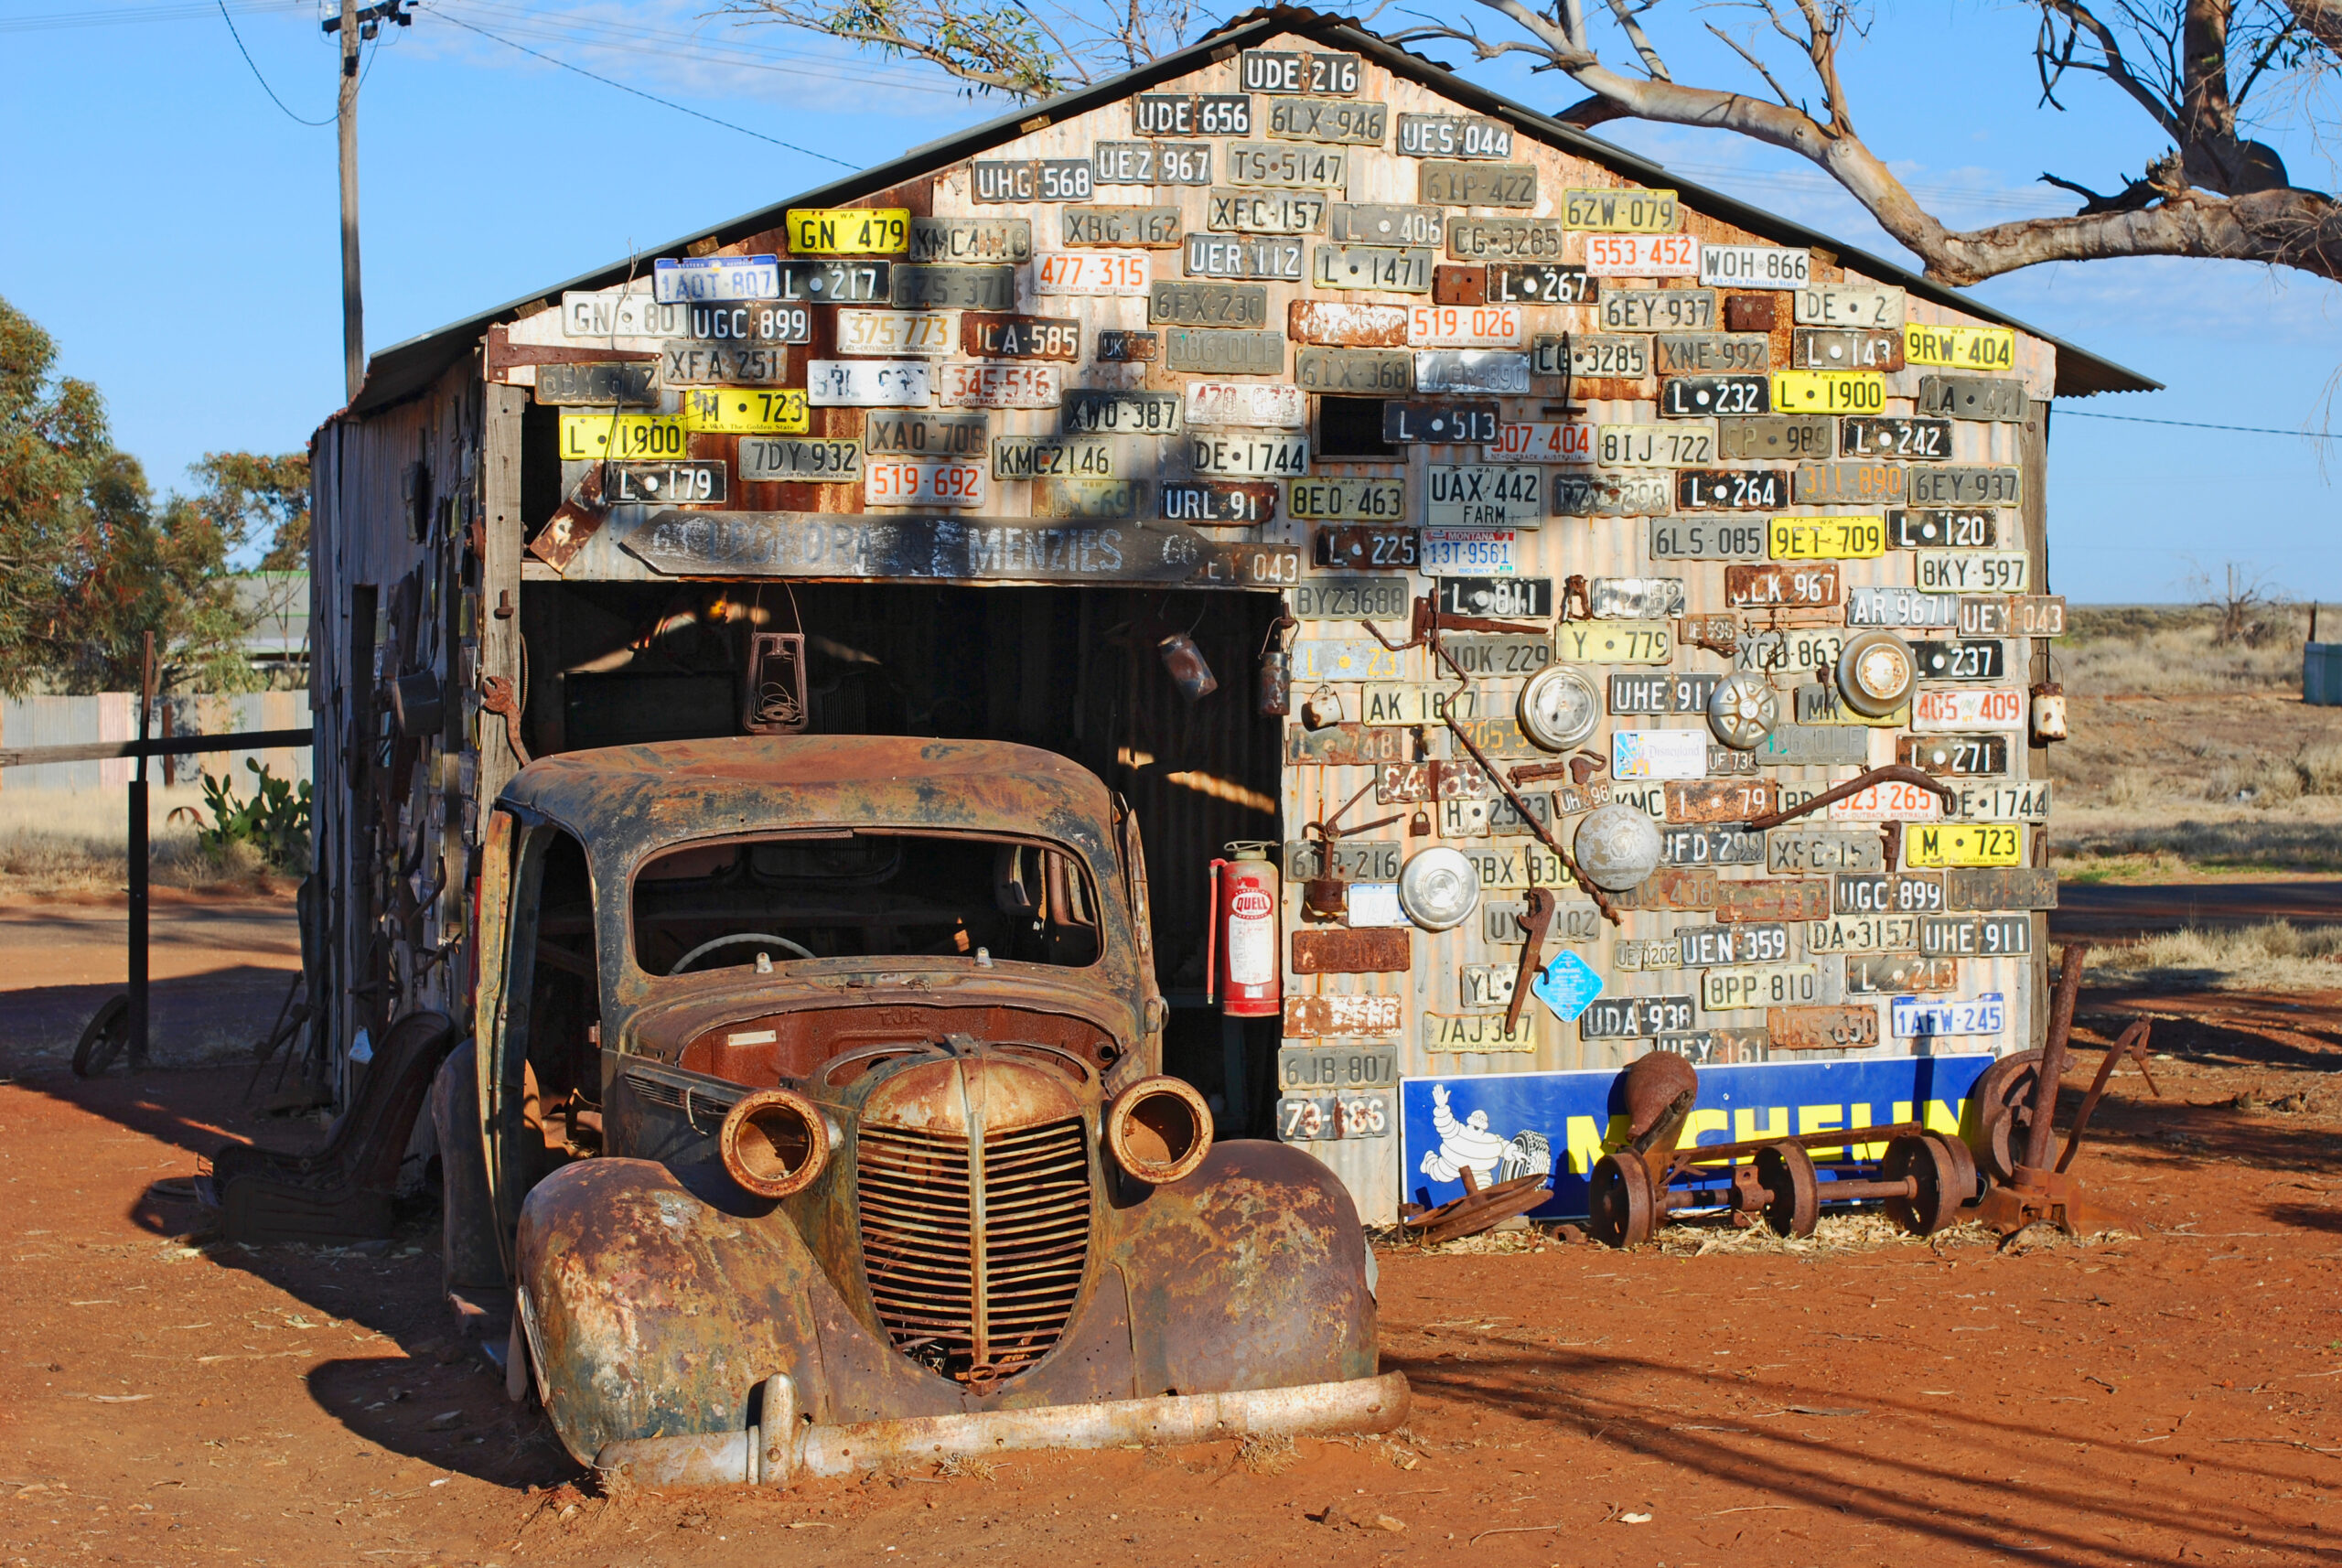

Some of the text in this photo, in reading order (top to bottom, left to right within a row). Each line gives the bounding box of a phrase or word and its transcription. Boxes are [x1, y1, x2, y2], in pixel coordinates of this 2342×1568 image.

[800, 220, 904, 248] GN 479
[1767, 254, 1807, 280] 866
[830, 269, 876, 299] 217
[1542, 273, 1587, 302] 267
[1715, 384, 1759, 413] 232
[1829, 381, 1882, 409] 1900
[622, 424, 680, 453] 1900
[1898, 426, 1940, 456] 242
[1248, 443, 1305, 472] 1744
[669, 469, 713, 499] 179
[1734, 478, 1776, 507] 264
[1465, 506, 1506, 527] FARM
[1448, 532, 1494, 541] MONTANA
[1946, 517, 1985, 546] 120
[1370, 693, 1402, 720] AK
[1649, 744, 1701, 759] Disneyland
[1973, 829, 2016, 855] 723
[1236, 897, 1268, 911] QUELL
[1566, 1099, 1974, 1174] MCHELIN
